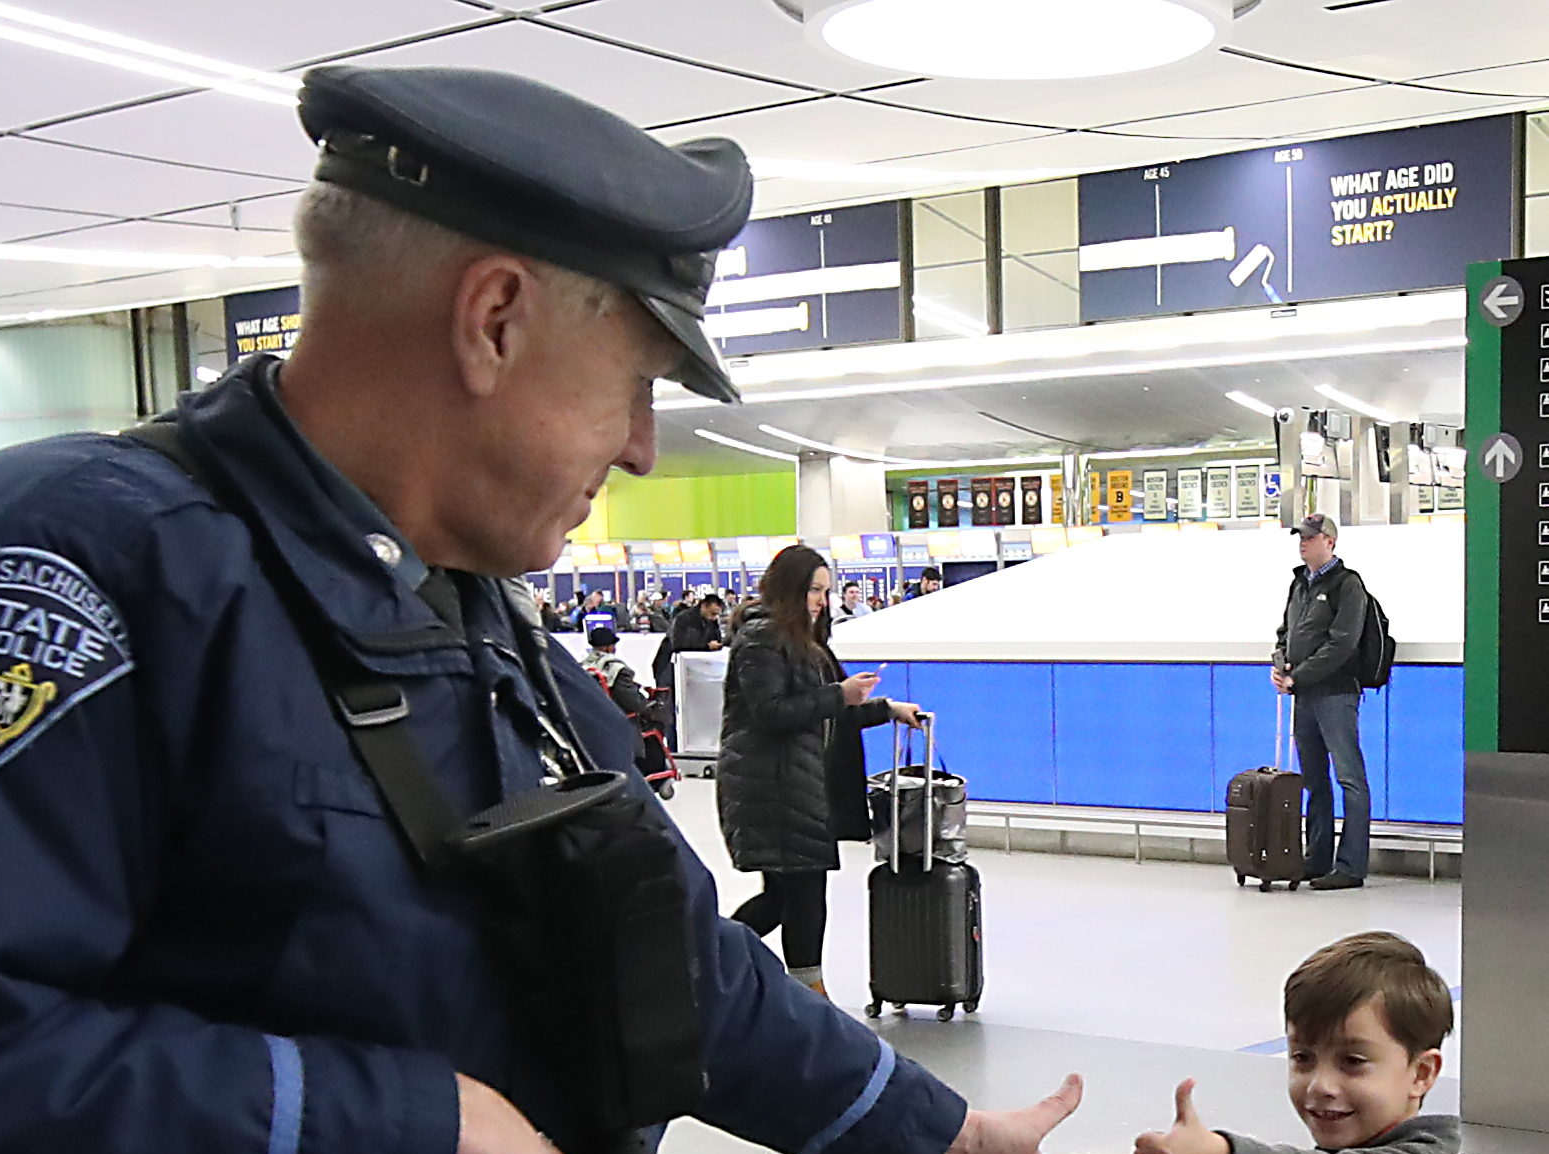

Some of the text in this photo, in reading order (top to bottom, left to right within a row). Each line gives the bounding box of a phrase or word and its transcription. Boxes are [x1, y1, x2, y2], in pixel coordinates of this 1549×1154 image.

[1274, 150, 1290, 162] AGE
[1143, 166, 1170, 180] AGE 45
[1330, 162, 1454, 197] WHAT AGE DID
[1330, 187, 1457, 221] YOU ACTUALLY
[1330, 219, 1394, 246] START?
[235, 319, 261, 336] WHAT
[262, 316, 280, 333] AGE
[236, 337, 256, 353] YOU
[256, 333, 283, 351] START
